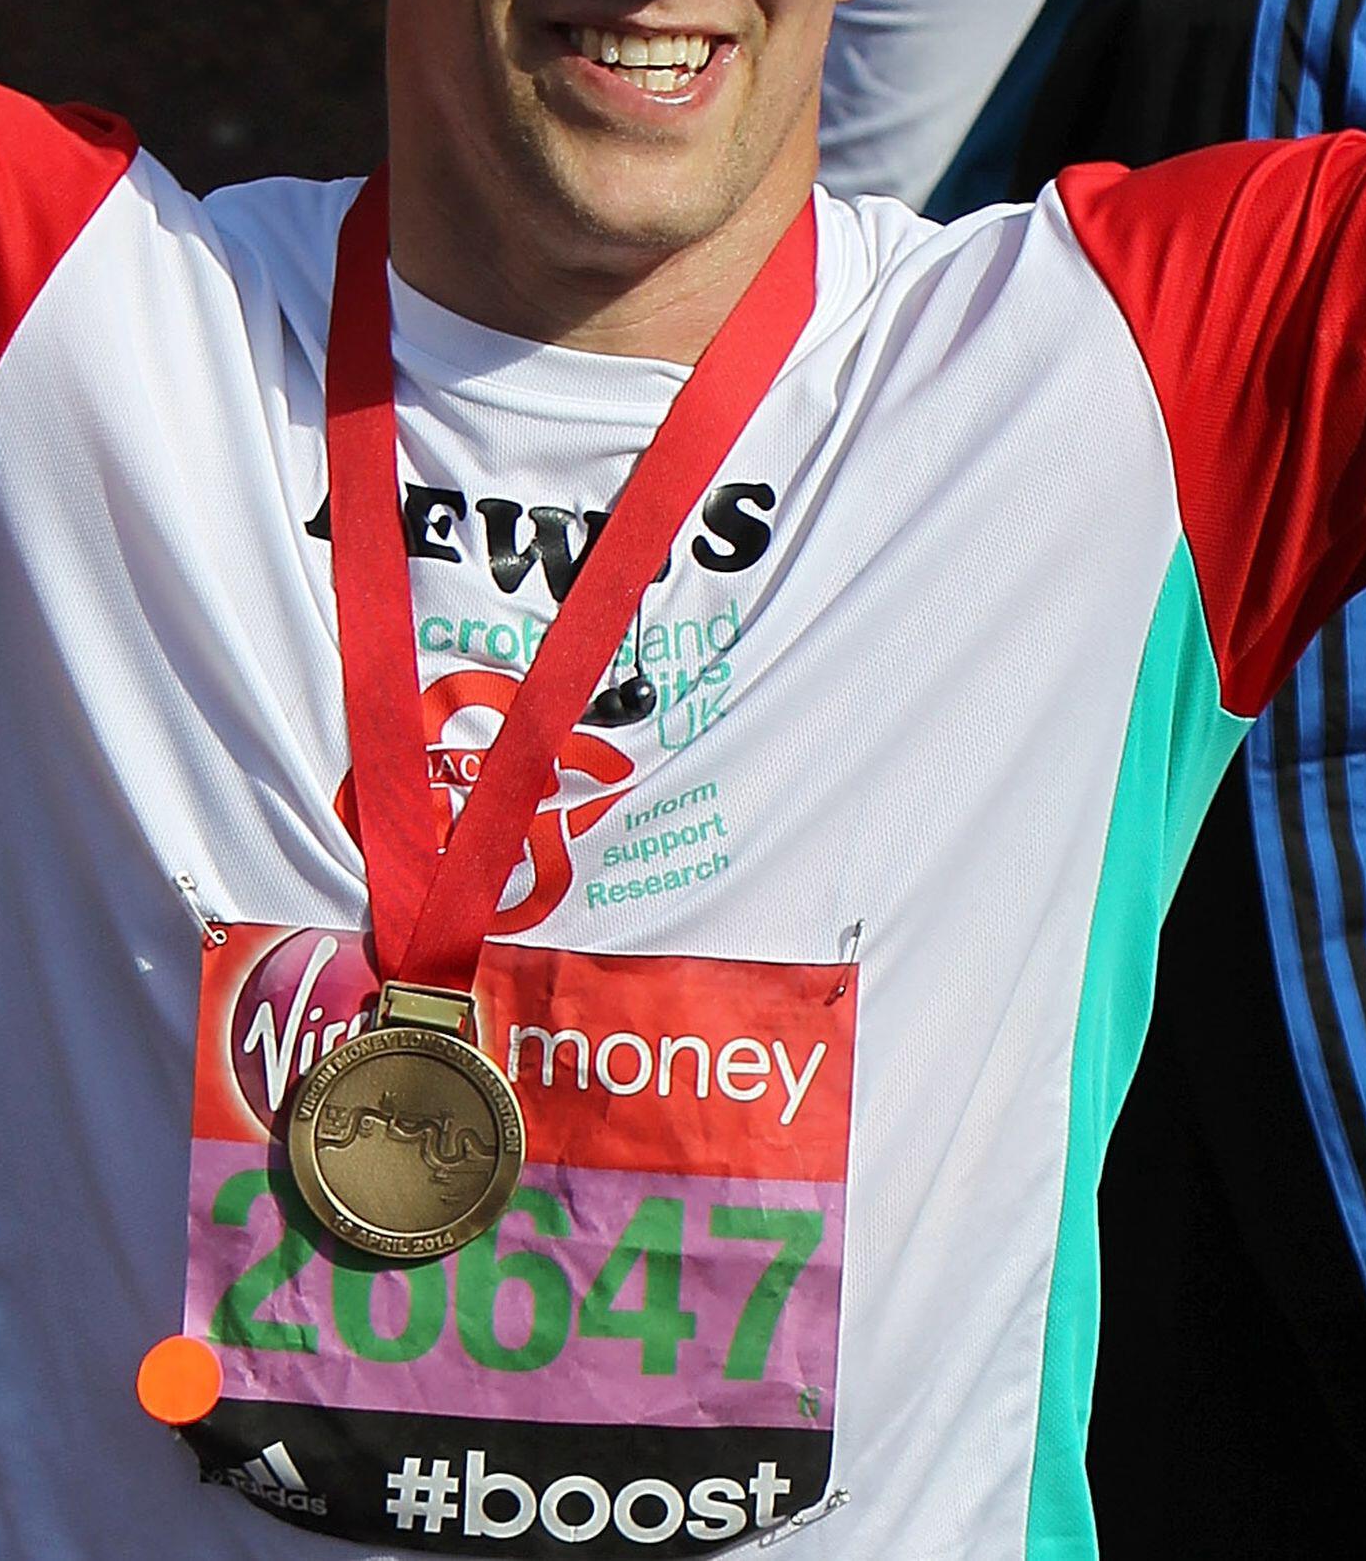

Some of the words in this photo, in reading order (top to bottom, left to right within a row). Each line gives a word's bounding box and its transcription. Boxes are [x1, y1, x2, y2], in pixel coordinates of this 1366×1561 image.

[304, 481, 776, 604] EWS
[602, 812, 729, 868] support
[624, 779, 719, 831] Inform
[585, 852, 730, 910] Research
[297, 1063, 338, 1120] VIRGIN
[333, 1032, 398, 1071] MONEY
[507, 1022, 827, 1125] money
[355, 1229, 409, 1253] APRIL
[412, 1231, 455, 1253] 2014
[386, 1450, 791, 1543] #boost
